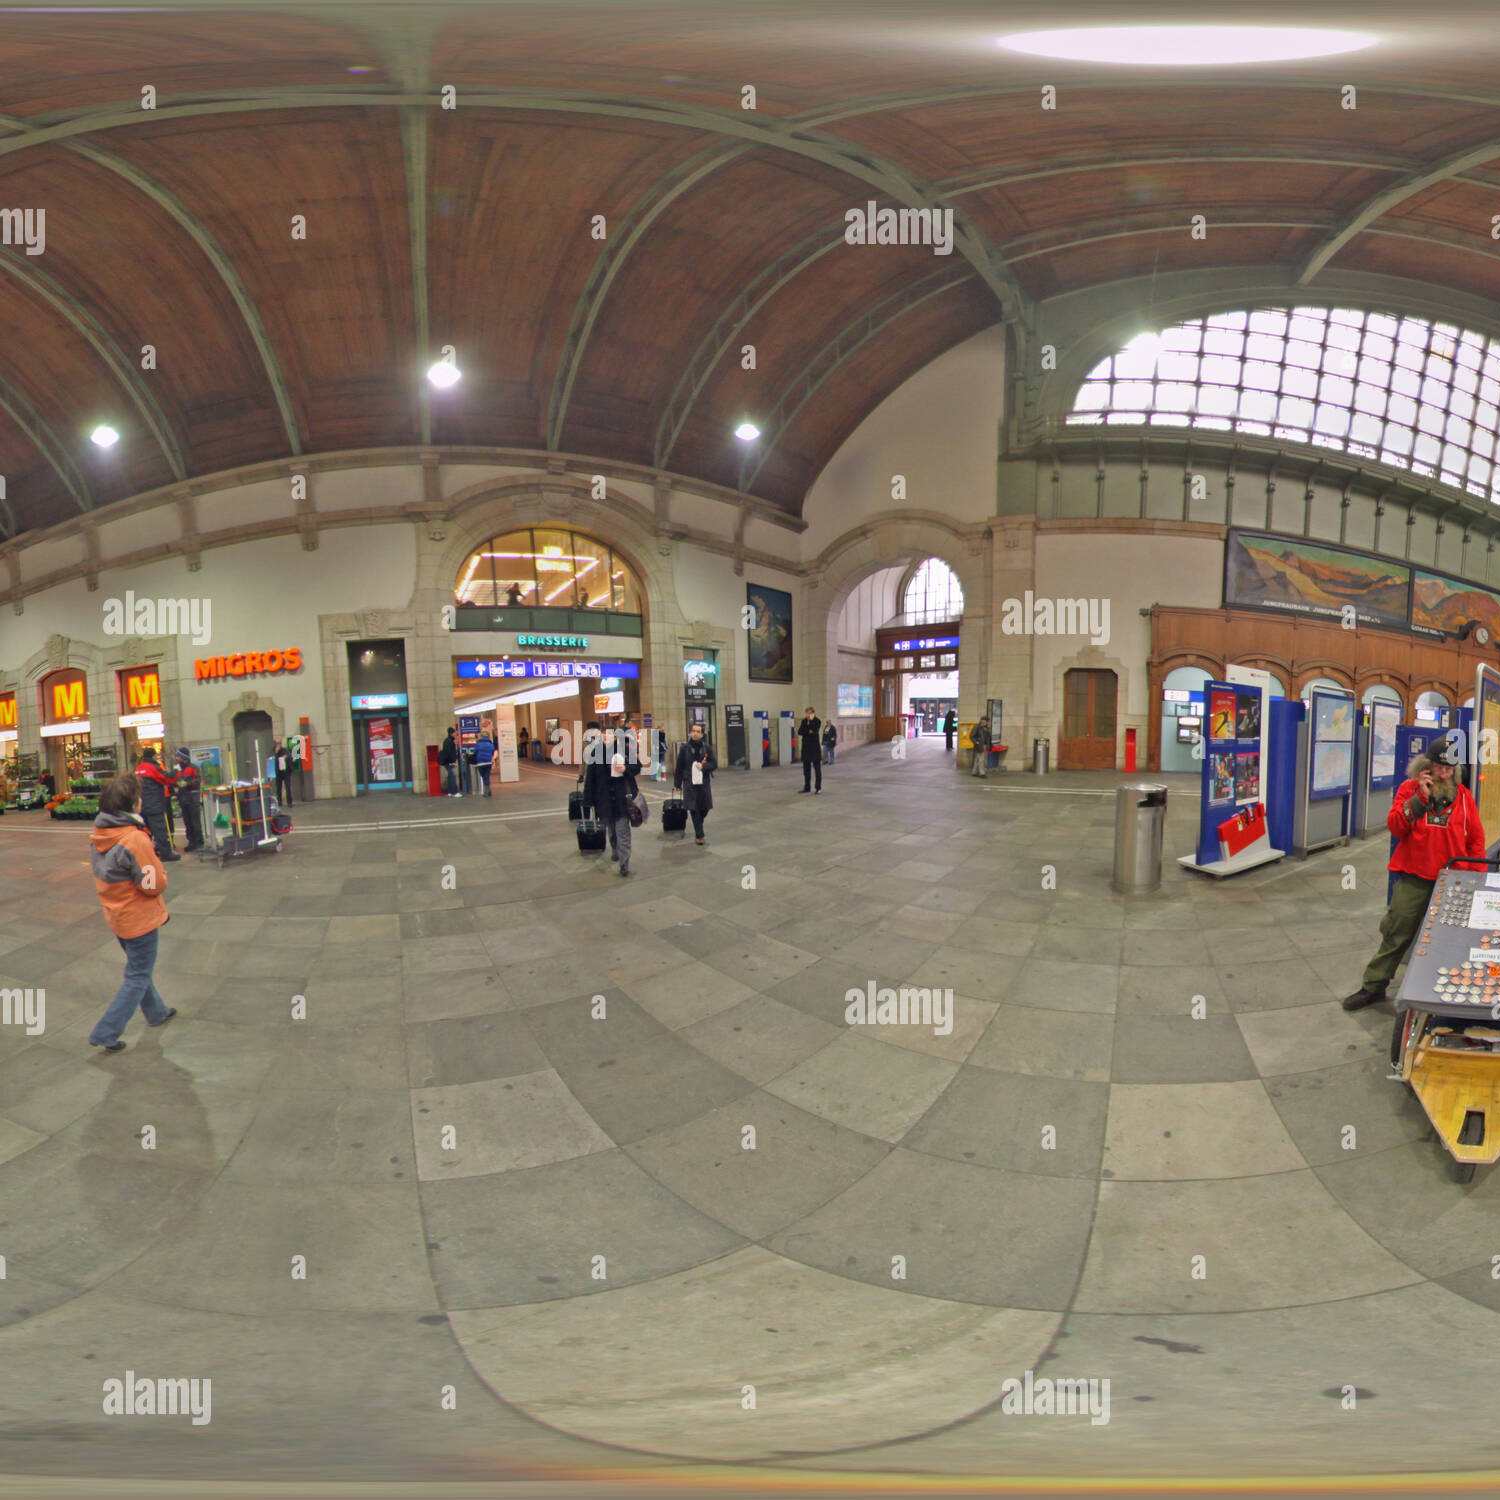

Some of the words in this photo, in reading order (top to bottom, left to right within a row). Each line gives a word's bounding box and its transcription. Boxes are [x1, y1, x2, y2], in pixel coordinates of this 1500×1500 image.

[518, 634, 589, 648] BRASSERIE
[194, 647, 302, 679] MIGROS
[53, 680, 85, 718] M
[127, 673, 160, 708] M
